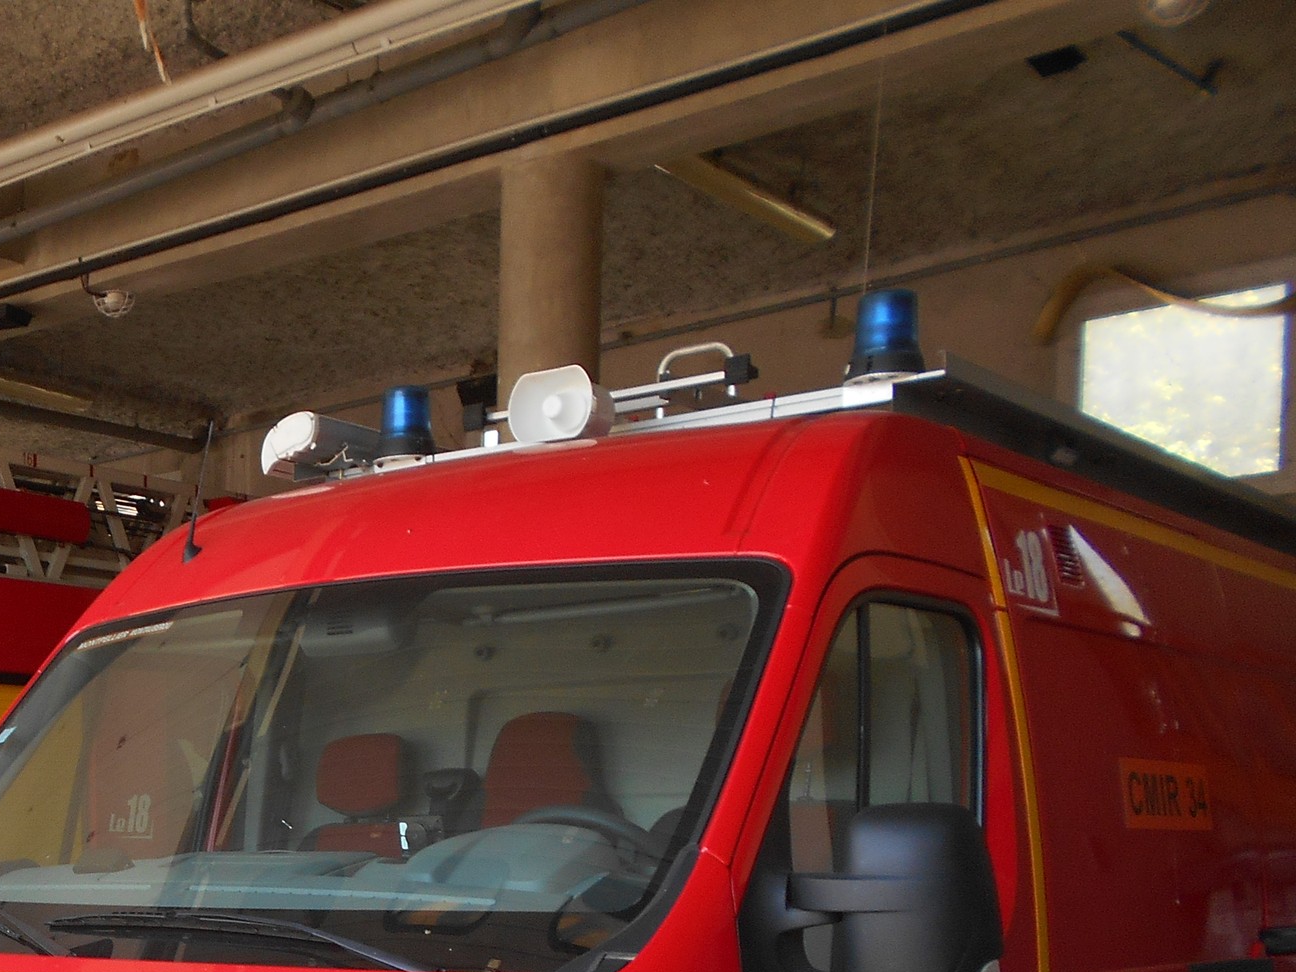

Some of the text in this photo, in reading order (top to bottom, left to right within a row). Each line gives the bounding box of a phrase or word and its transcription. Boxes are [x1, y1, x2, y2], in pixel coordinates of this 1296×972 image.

[1016, 529, 1049, 603] 18
[127, 793, 151, 834] 18
[1128, 771, 1208, 818] CMIR 34
